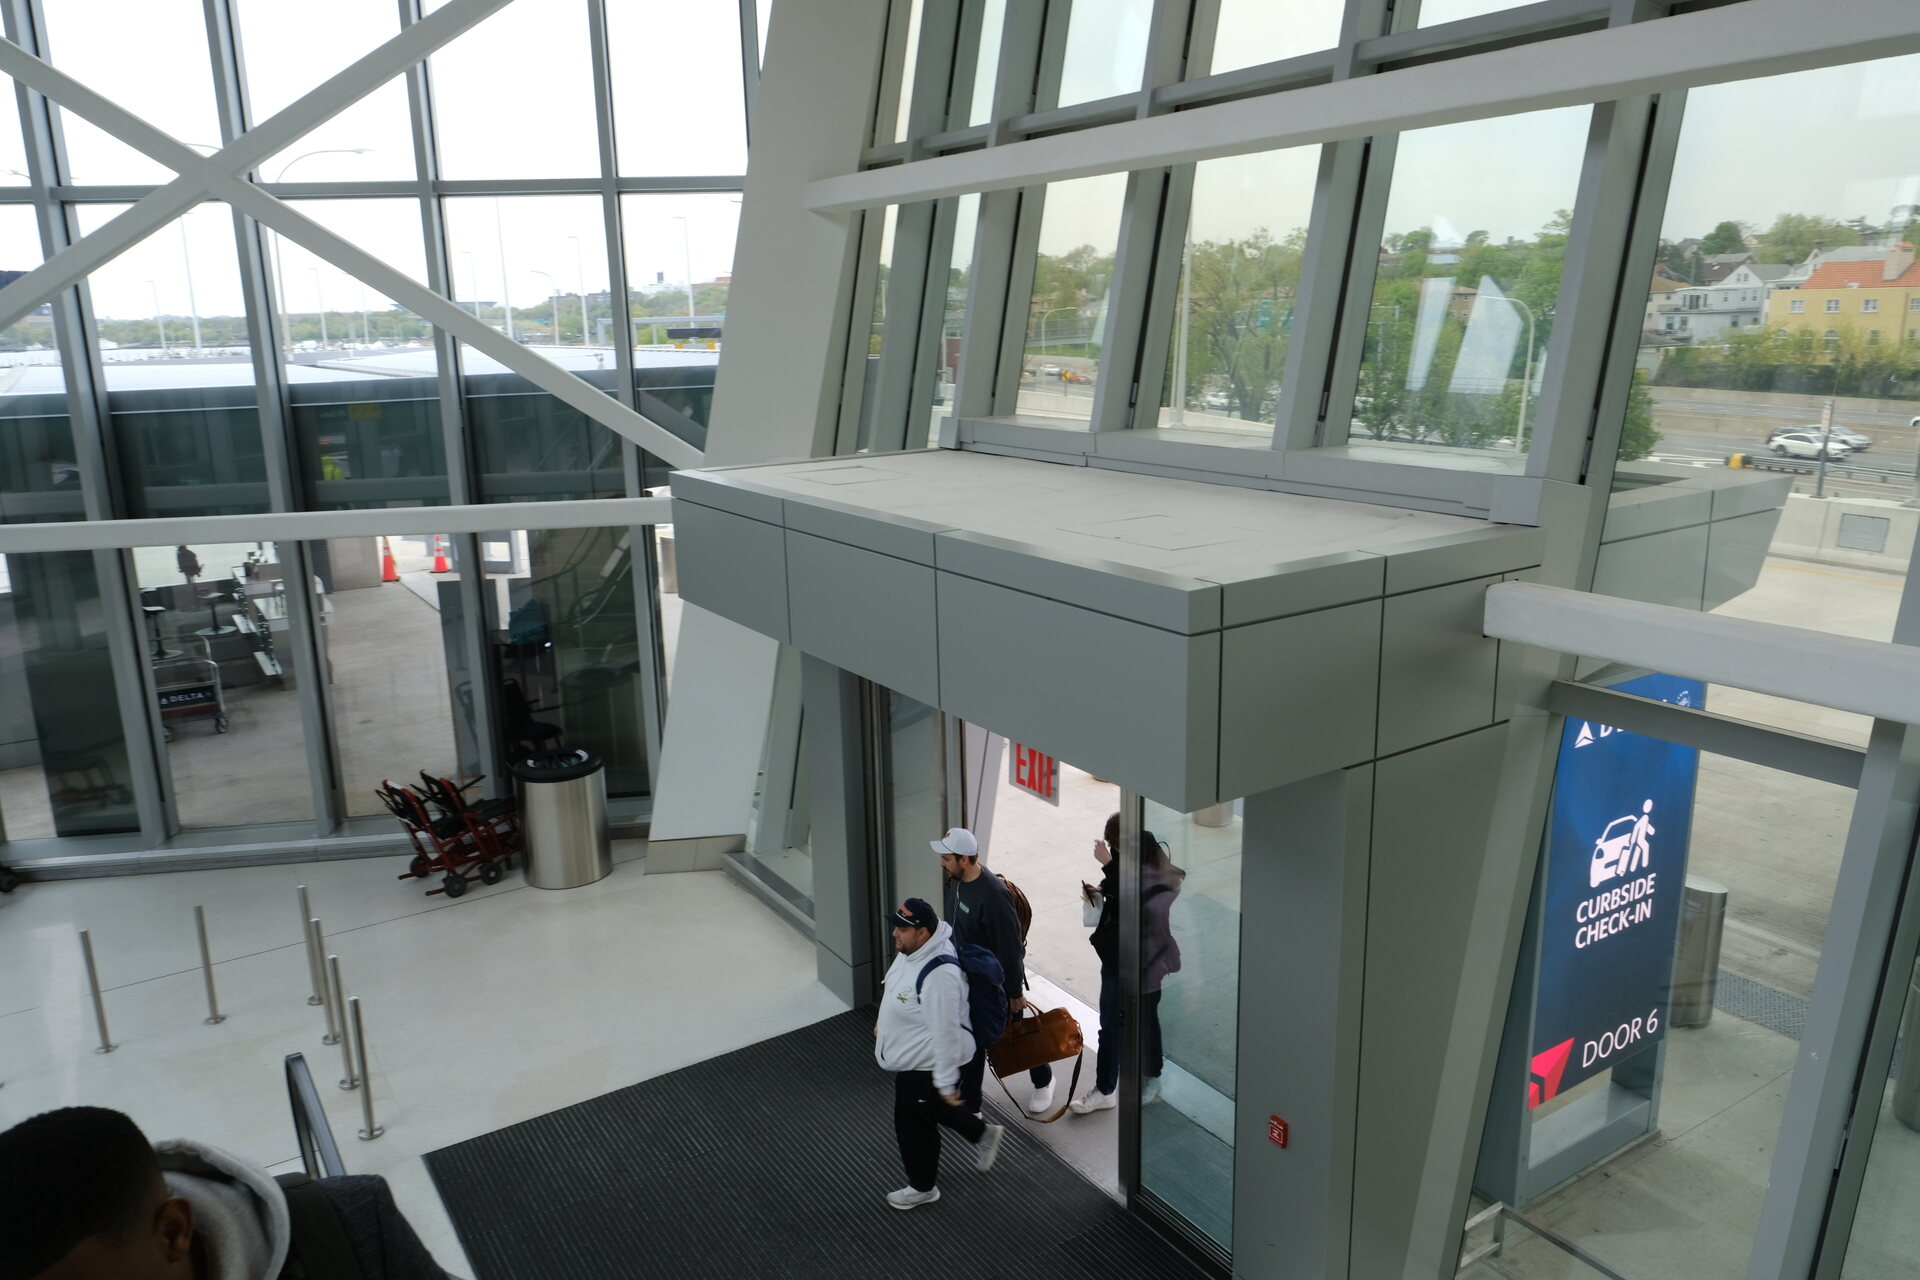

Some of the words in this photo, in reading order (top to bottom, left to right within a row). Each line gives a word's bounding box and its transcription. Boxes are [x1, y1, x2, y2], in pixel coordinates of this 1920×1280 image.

[169, 692, 204, 703] DELTA
[1576, 872, 1656, 923] CURBSIDE
[1575, 899, 1653, 948] CHECK-IN
[1582, 1017, 1641, 1067] DOOR
[1646, 1008, 1658, 1033] 6
